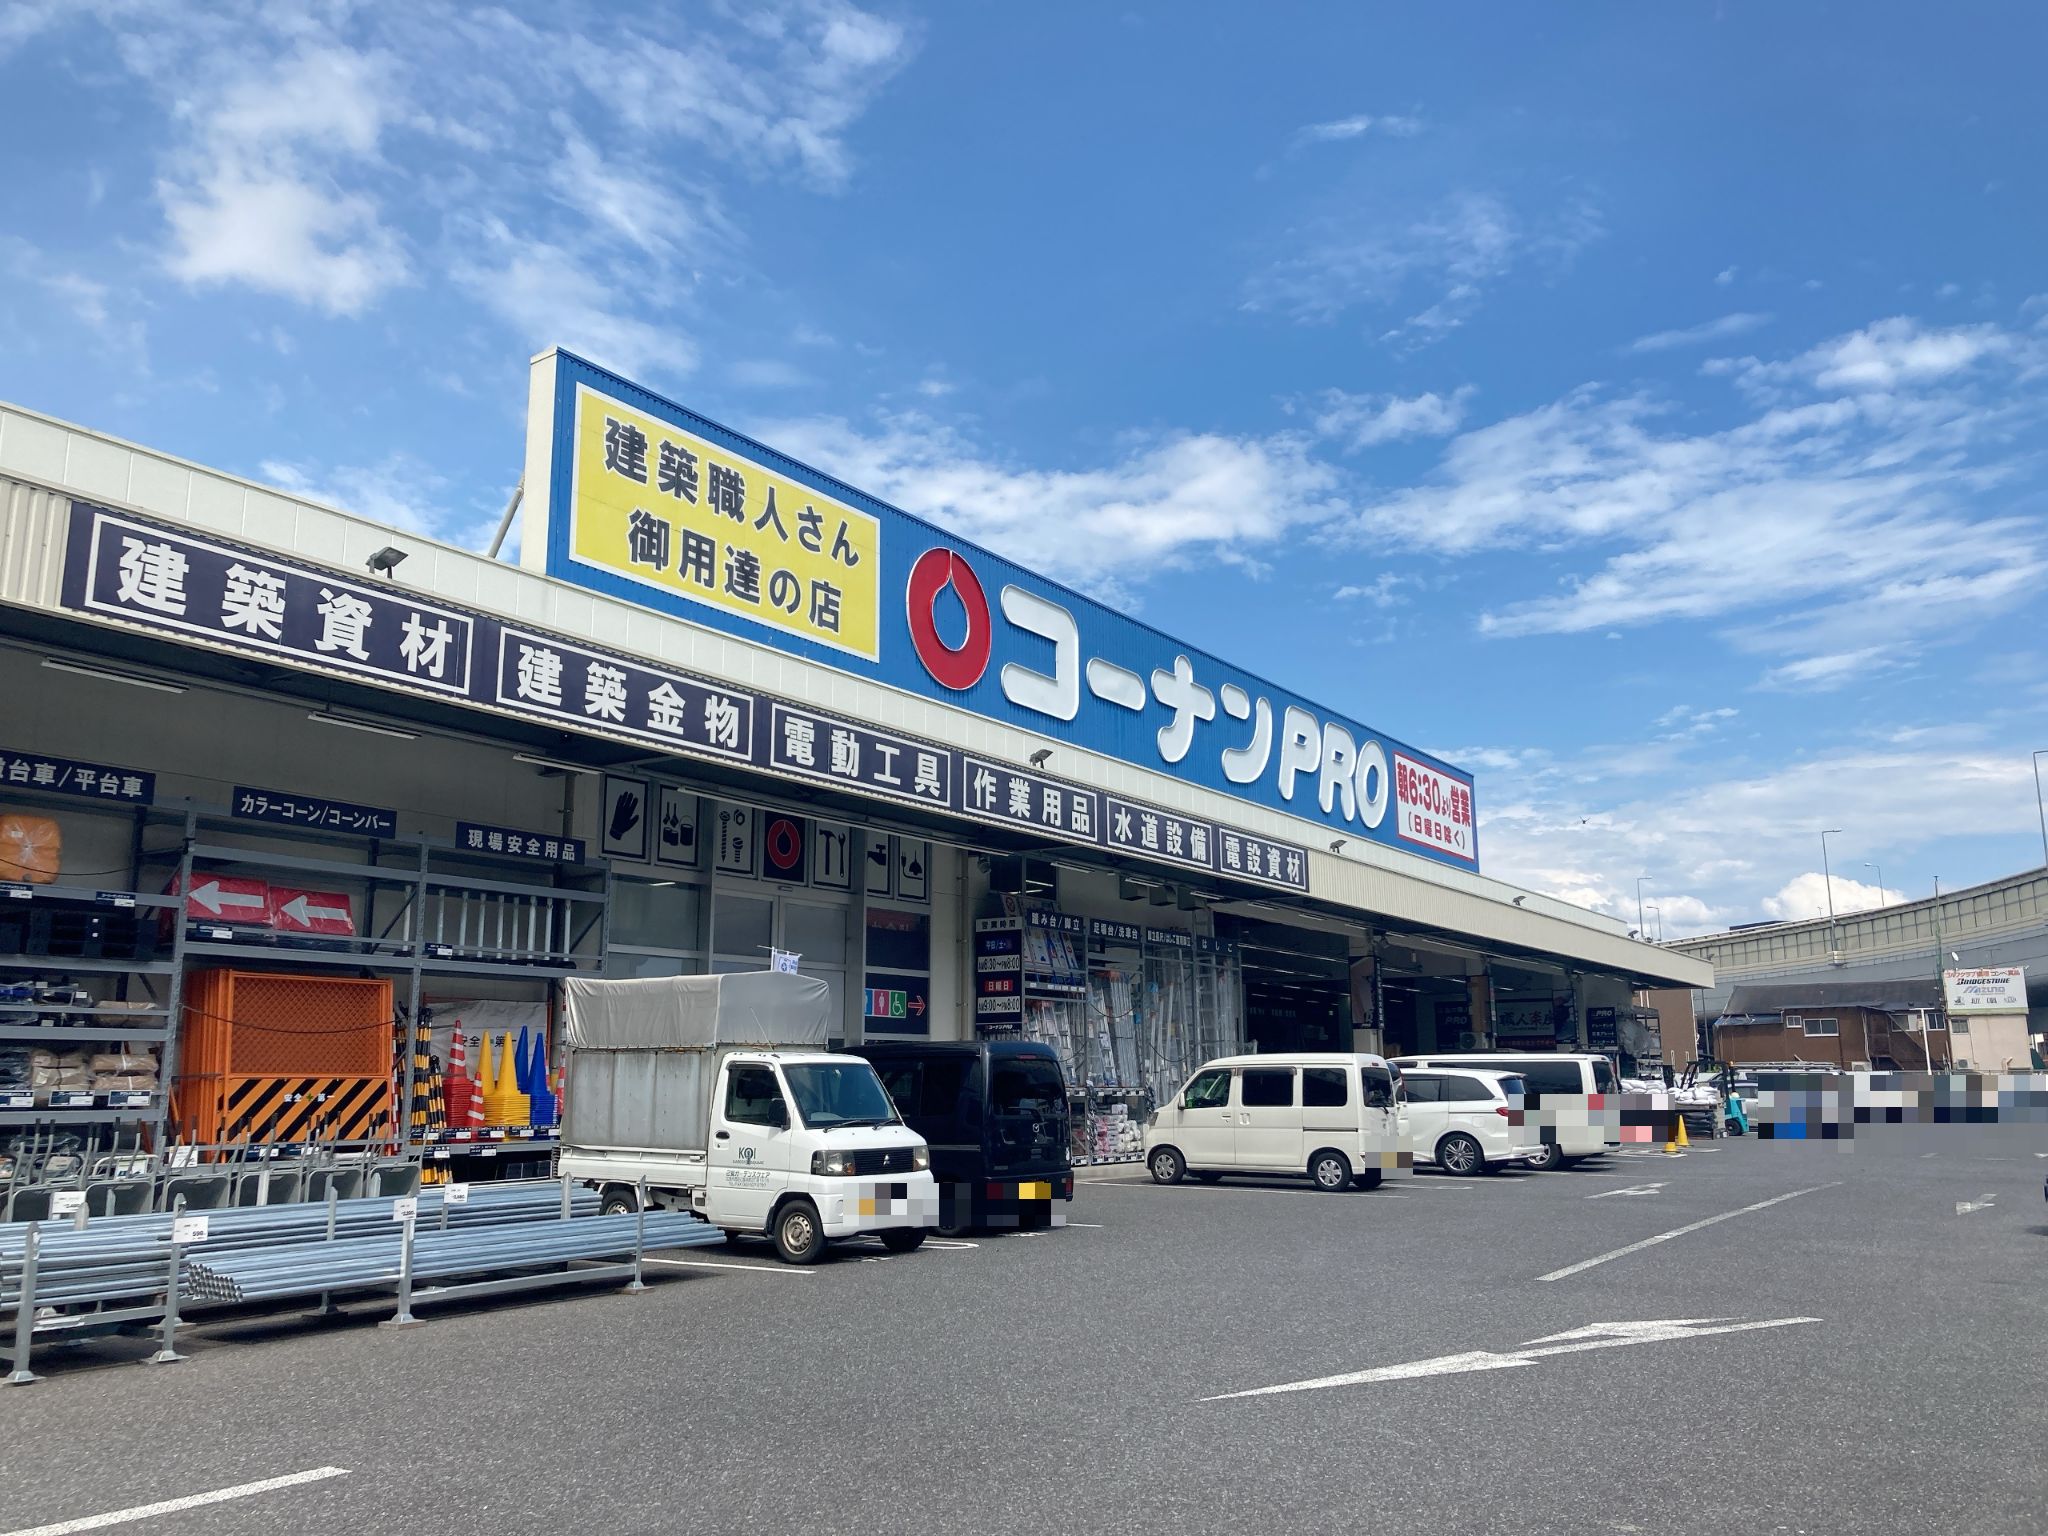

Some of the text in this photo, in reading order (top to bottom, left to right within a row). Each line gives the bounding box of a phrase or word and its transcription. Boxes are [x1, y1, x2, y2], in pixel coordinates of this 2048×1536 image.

[603, 416, 861, 569] 建築職人さん
[627, 508, 843, 635] 御用達の店
[117, 534, 453, 680] 建築資材
[516, 643, 740, 750] 建築金物
[783, 715, 942, 798] 電動工具
[241, 794, 391, 830] カラーコーン/コーンバー
[972, 766, 1091, 835] 作業用品
[467, 828, 576, 862] 現場安全用品
[1113, 810, 1207, 863] 水道設備
[1225, 841, 1302, 884] 電設資材
[988, 980, 1009, 991] 日曜日
[738, 1147, 757, 1160] KOI
